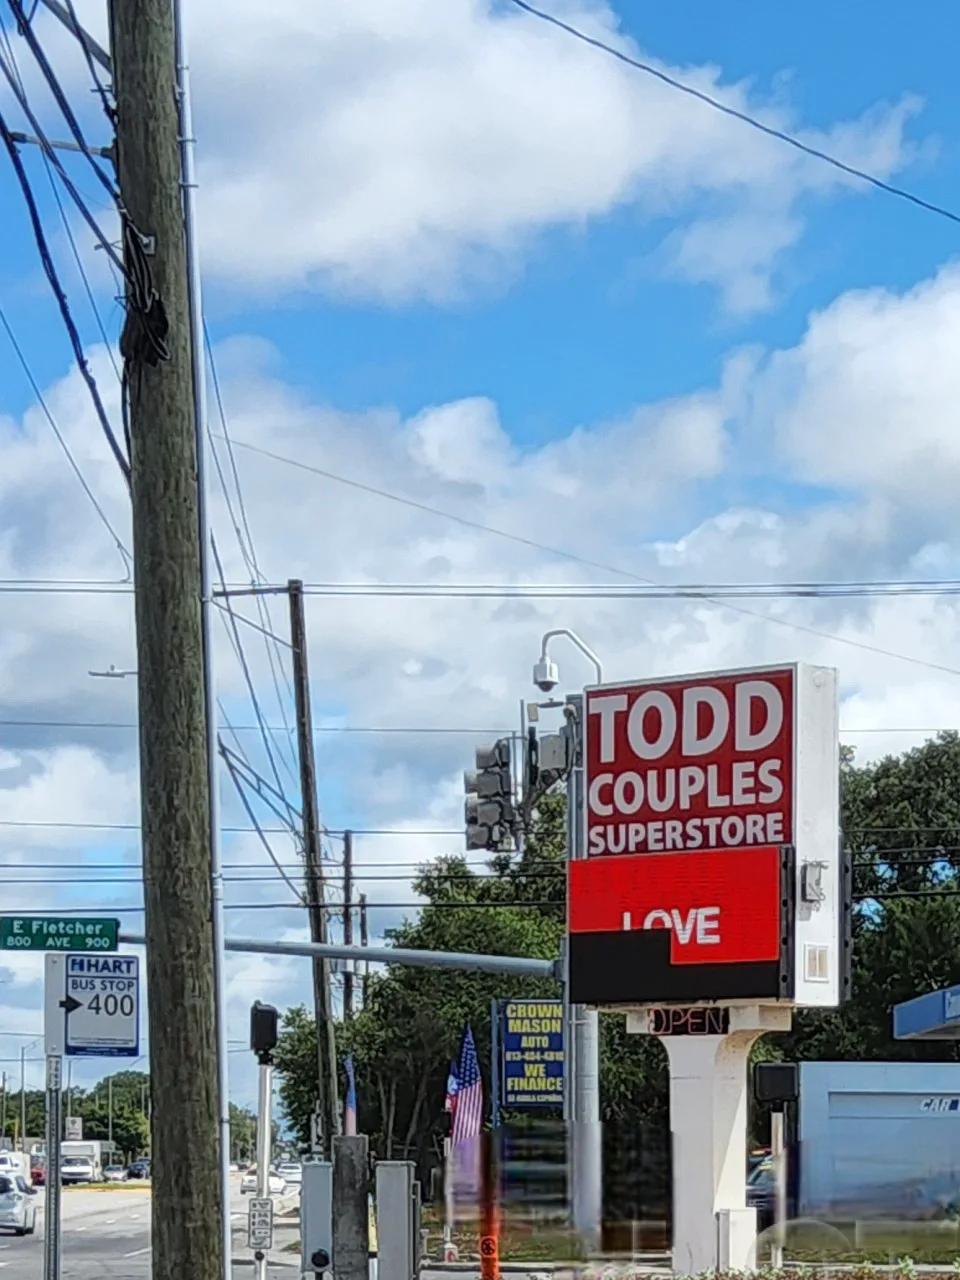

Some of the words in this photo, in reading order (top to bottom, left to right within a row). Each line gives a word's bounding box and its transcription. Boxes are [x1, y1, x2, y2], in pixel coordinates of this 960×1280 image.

[589, 680, 784, 763] TODD
[589, 759, 783, 816] COUPLES
[589, 812, 784, 854] SUPERSTORE
[12, 920, 24, 934] E
[31, 920, 103, 935] Fletcher
[7, 936, 32, 947] 800
[45, 937, 72, 948] AVE
[84, 937, 110, 949] 900
[87, 959, 135, 974] HART
[71, 979, 96, 991] BUS
[100, 979, 135, 992] STOP
[87, 993, 135, 1017] 400
[505, 1003, 563, 1018] CROWN
[507, 1019, 562, 1033] MASON
[648, 1006, 723, 1036] OPEN
[520, 1035, 549, 1048] AUTO
[523, 1063, 547, 1077] WE
[506, 1076, 563, 1091] FINANCE
[919, 1098, 951, 1112] CAR
